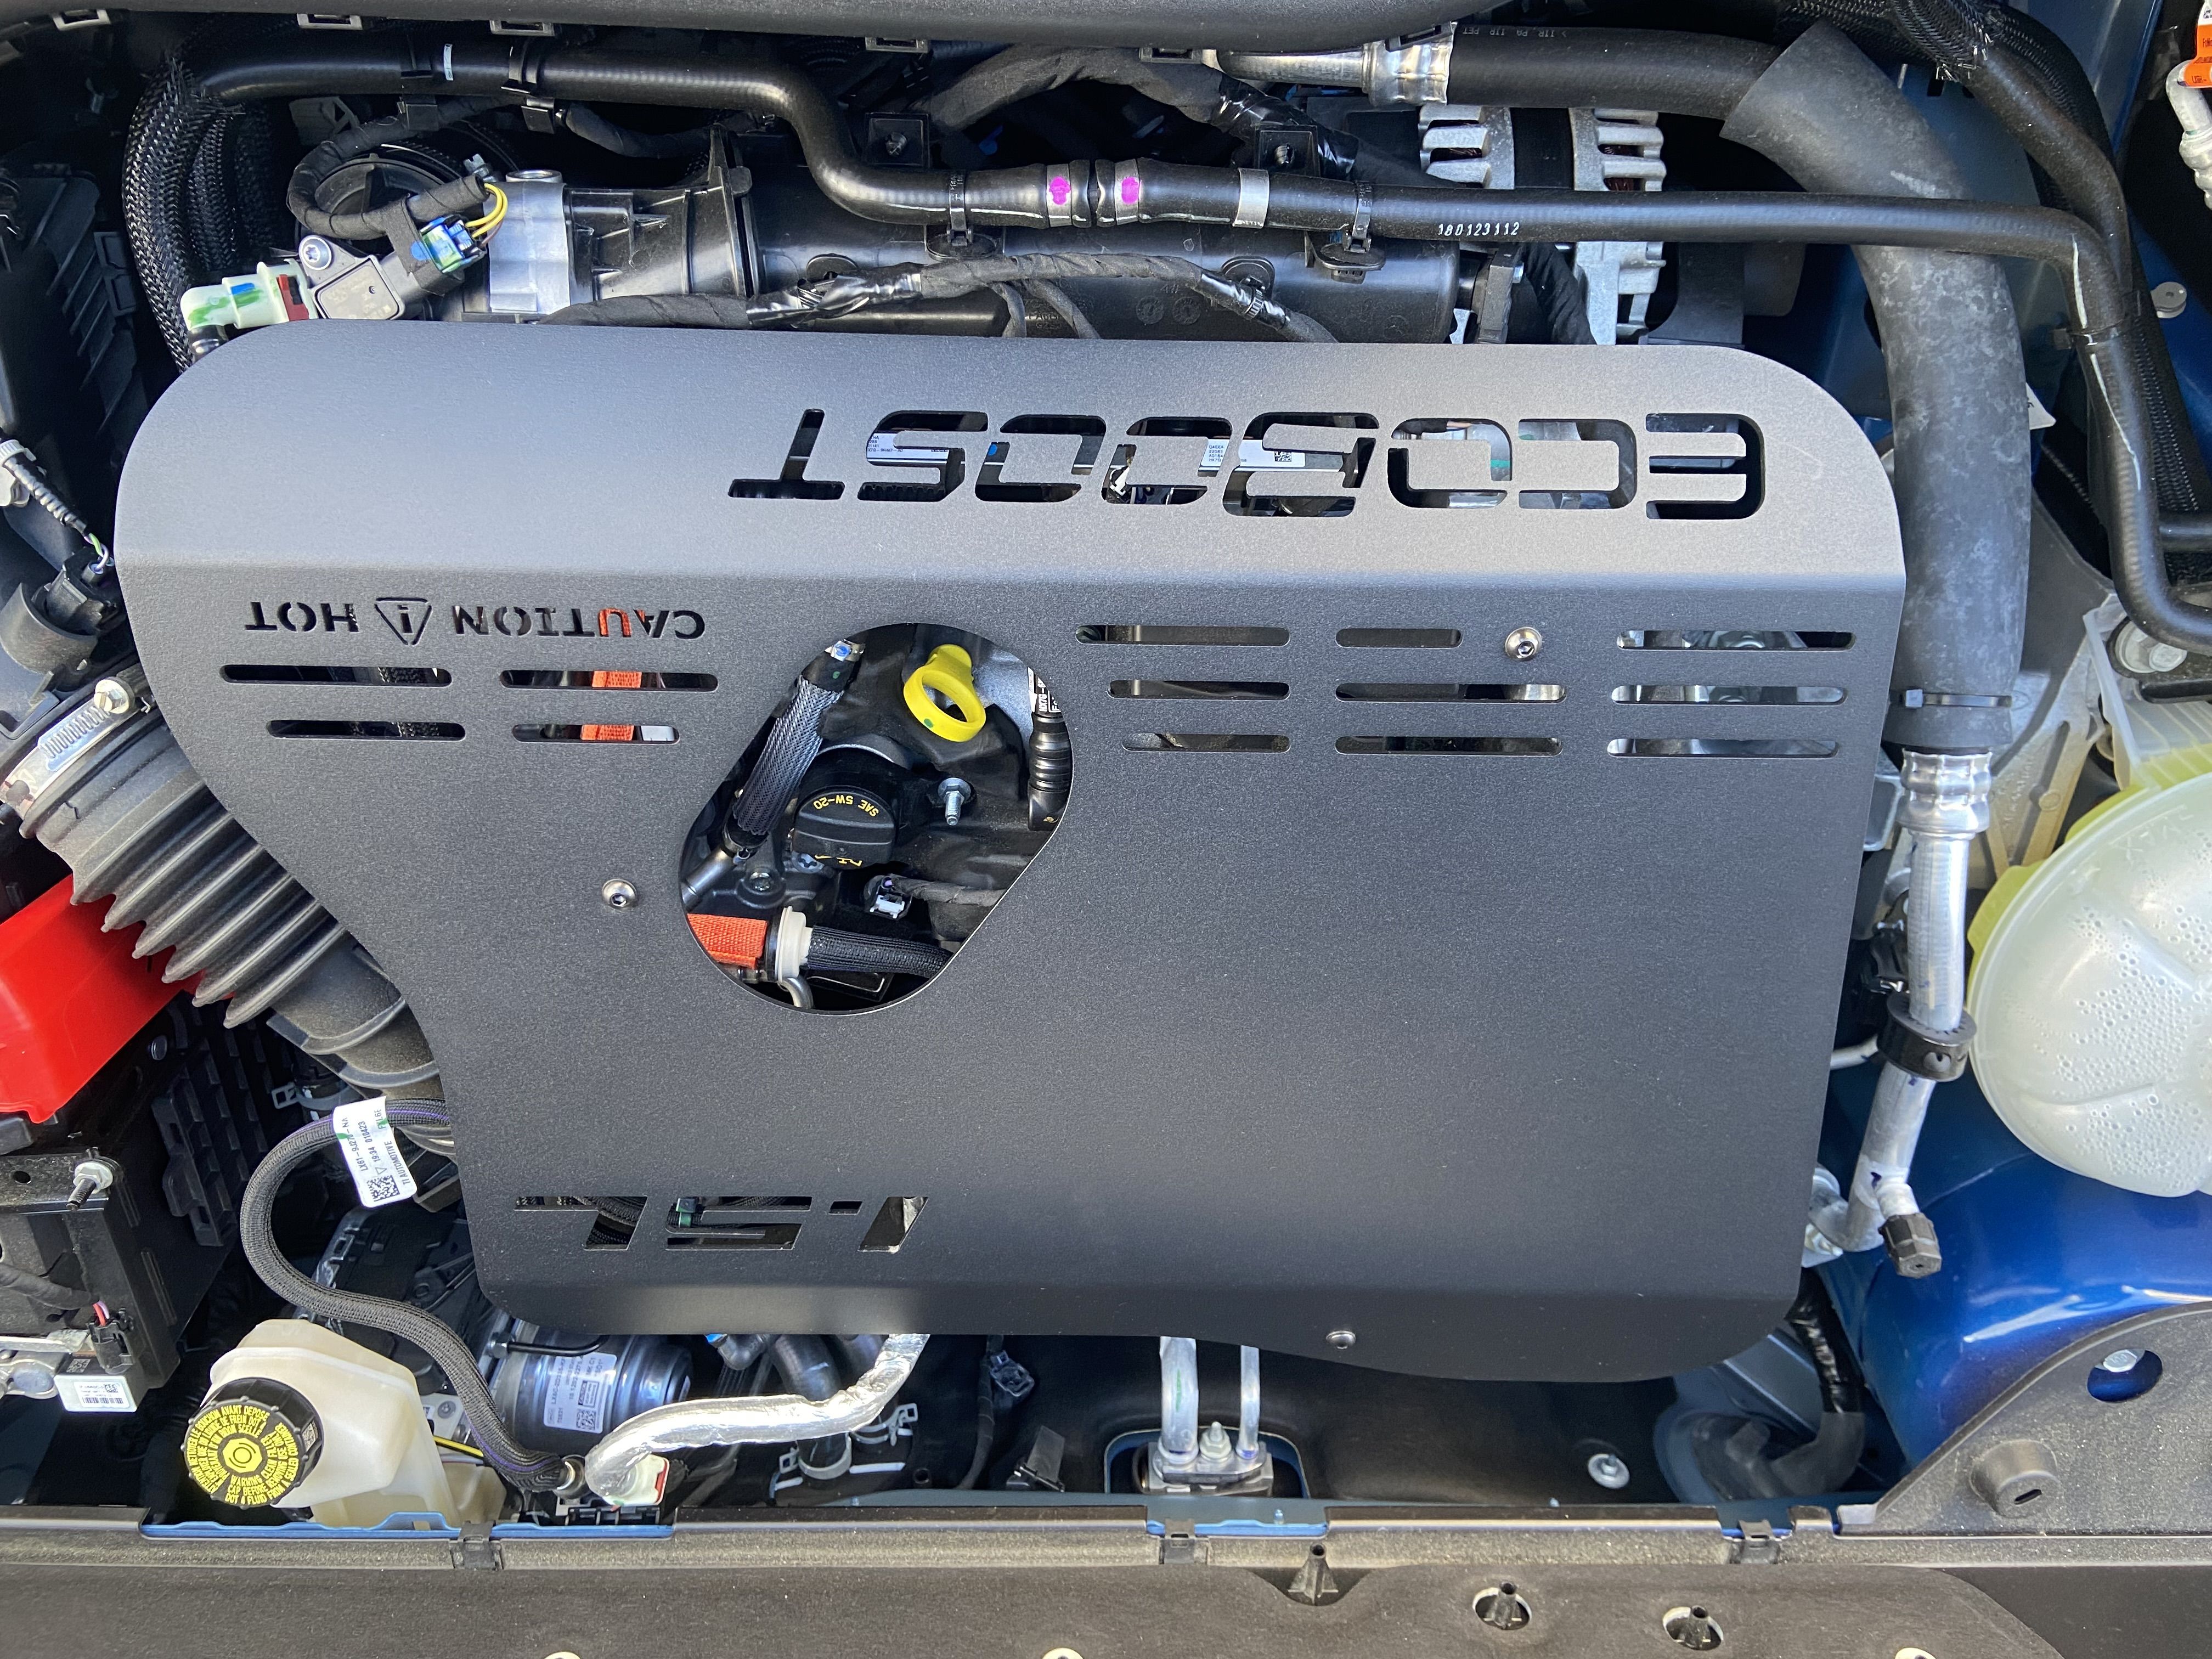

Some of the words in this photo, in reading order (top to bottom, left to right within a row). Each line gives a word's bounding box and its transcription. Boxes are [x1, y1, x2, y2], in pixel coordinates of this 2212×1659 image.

[1462, 27, 1480, 35] PET
[1438, 222, 1520, 236] 180123112
[728, 408, 1765, 520] ECOBOOST
[245, 601, 359, 632] HOT
[453, 606, 706, 640] CAUTION
[813, 795, 854, 809] 5W-20
[858, 799, 879, 817] SAE
[358, 1121, 373, 1143] 010423
[384, 1140, 408, 1177] AUTOMOTIVE
[514, 1195, 929, 1252] 1.5L
[221, 1404, 241, 1416] AVANT
[244, 1406, 269, 1421] DEPOSE
[219, 1415, 230, 1426] DE
[228, 1414, 247, 1424] FREIN
[248, 1415, 261, 1427] DOT
[190, 1427, 202, 1438] LE
[237, 1423, 262, 1438] SCELLE
[267, 1430, 284, 1447] ONLY
[274, 1423, 298, 1456] CONTAINER
[260, 1435, 278, 1458] FILLER
[276, 1446, 289, 1460] USE
[260, 1459, 278, 1480] CLEAN
[265, 1460, 289, 1488] REMOVING
[284, 1457, 298, 1481] SEALED
[191, 1466, 218, 1493] ATTENTION
[230, 1474, 262, 1487] WARNING
[279, 1479, 290, 1487] A
[227, 1483, 241, 1496] CAP
[242, 1482, 268, 1496] BEFORE
[266, 1483, 285, 1499] FROM
[225, 1492, 239, 1503] DOT
[247, 1493, 267, 1505] FLUID
